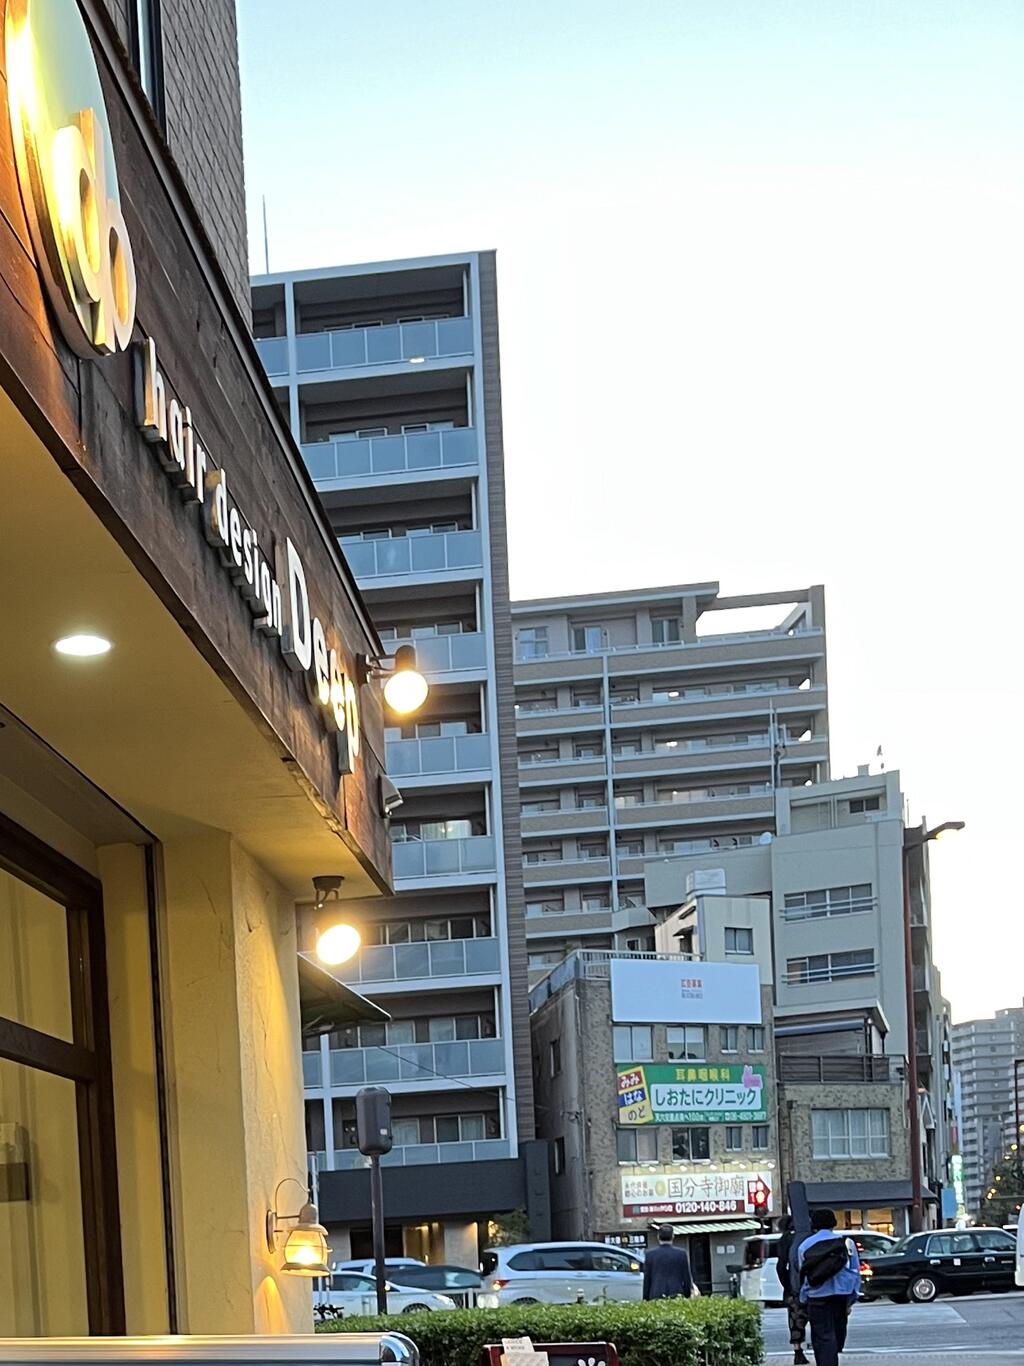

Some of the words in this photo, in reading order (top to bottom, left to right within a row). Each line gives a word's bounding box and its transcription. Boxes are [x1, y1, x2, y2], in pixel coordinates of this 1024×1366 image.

[143, 336, 208, 503] hair
[212, 468, 284, 638] design
[285, 536, 361, 775] Deep
[620, 1072, 641, 1088] みみ
[623, 1090, 644, 1106] はな
[655, 1087, 757, 1107] しおたにクリニック
[628, 1106, 646, 1121] のど
[675, 1199, 737, 1214] 0120-140-846
